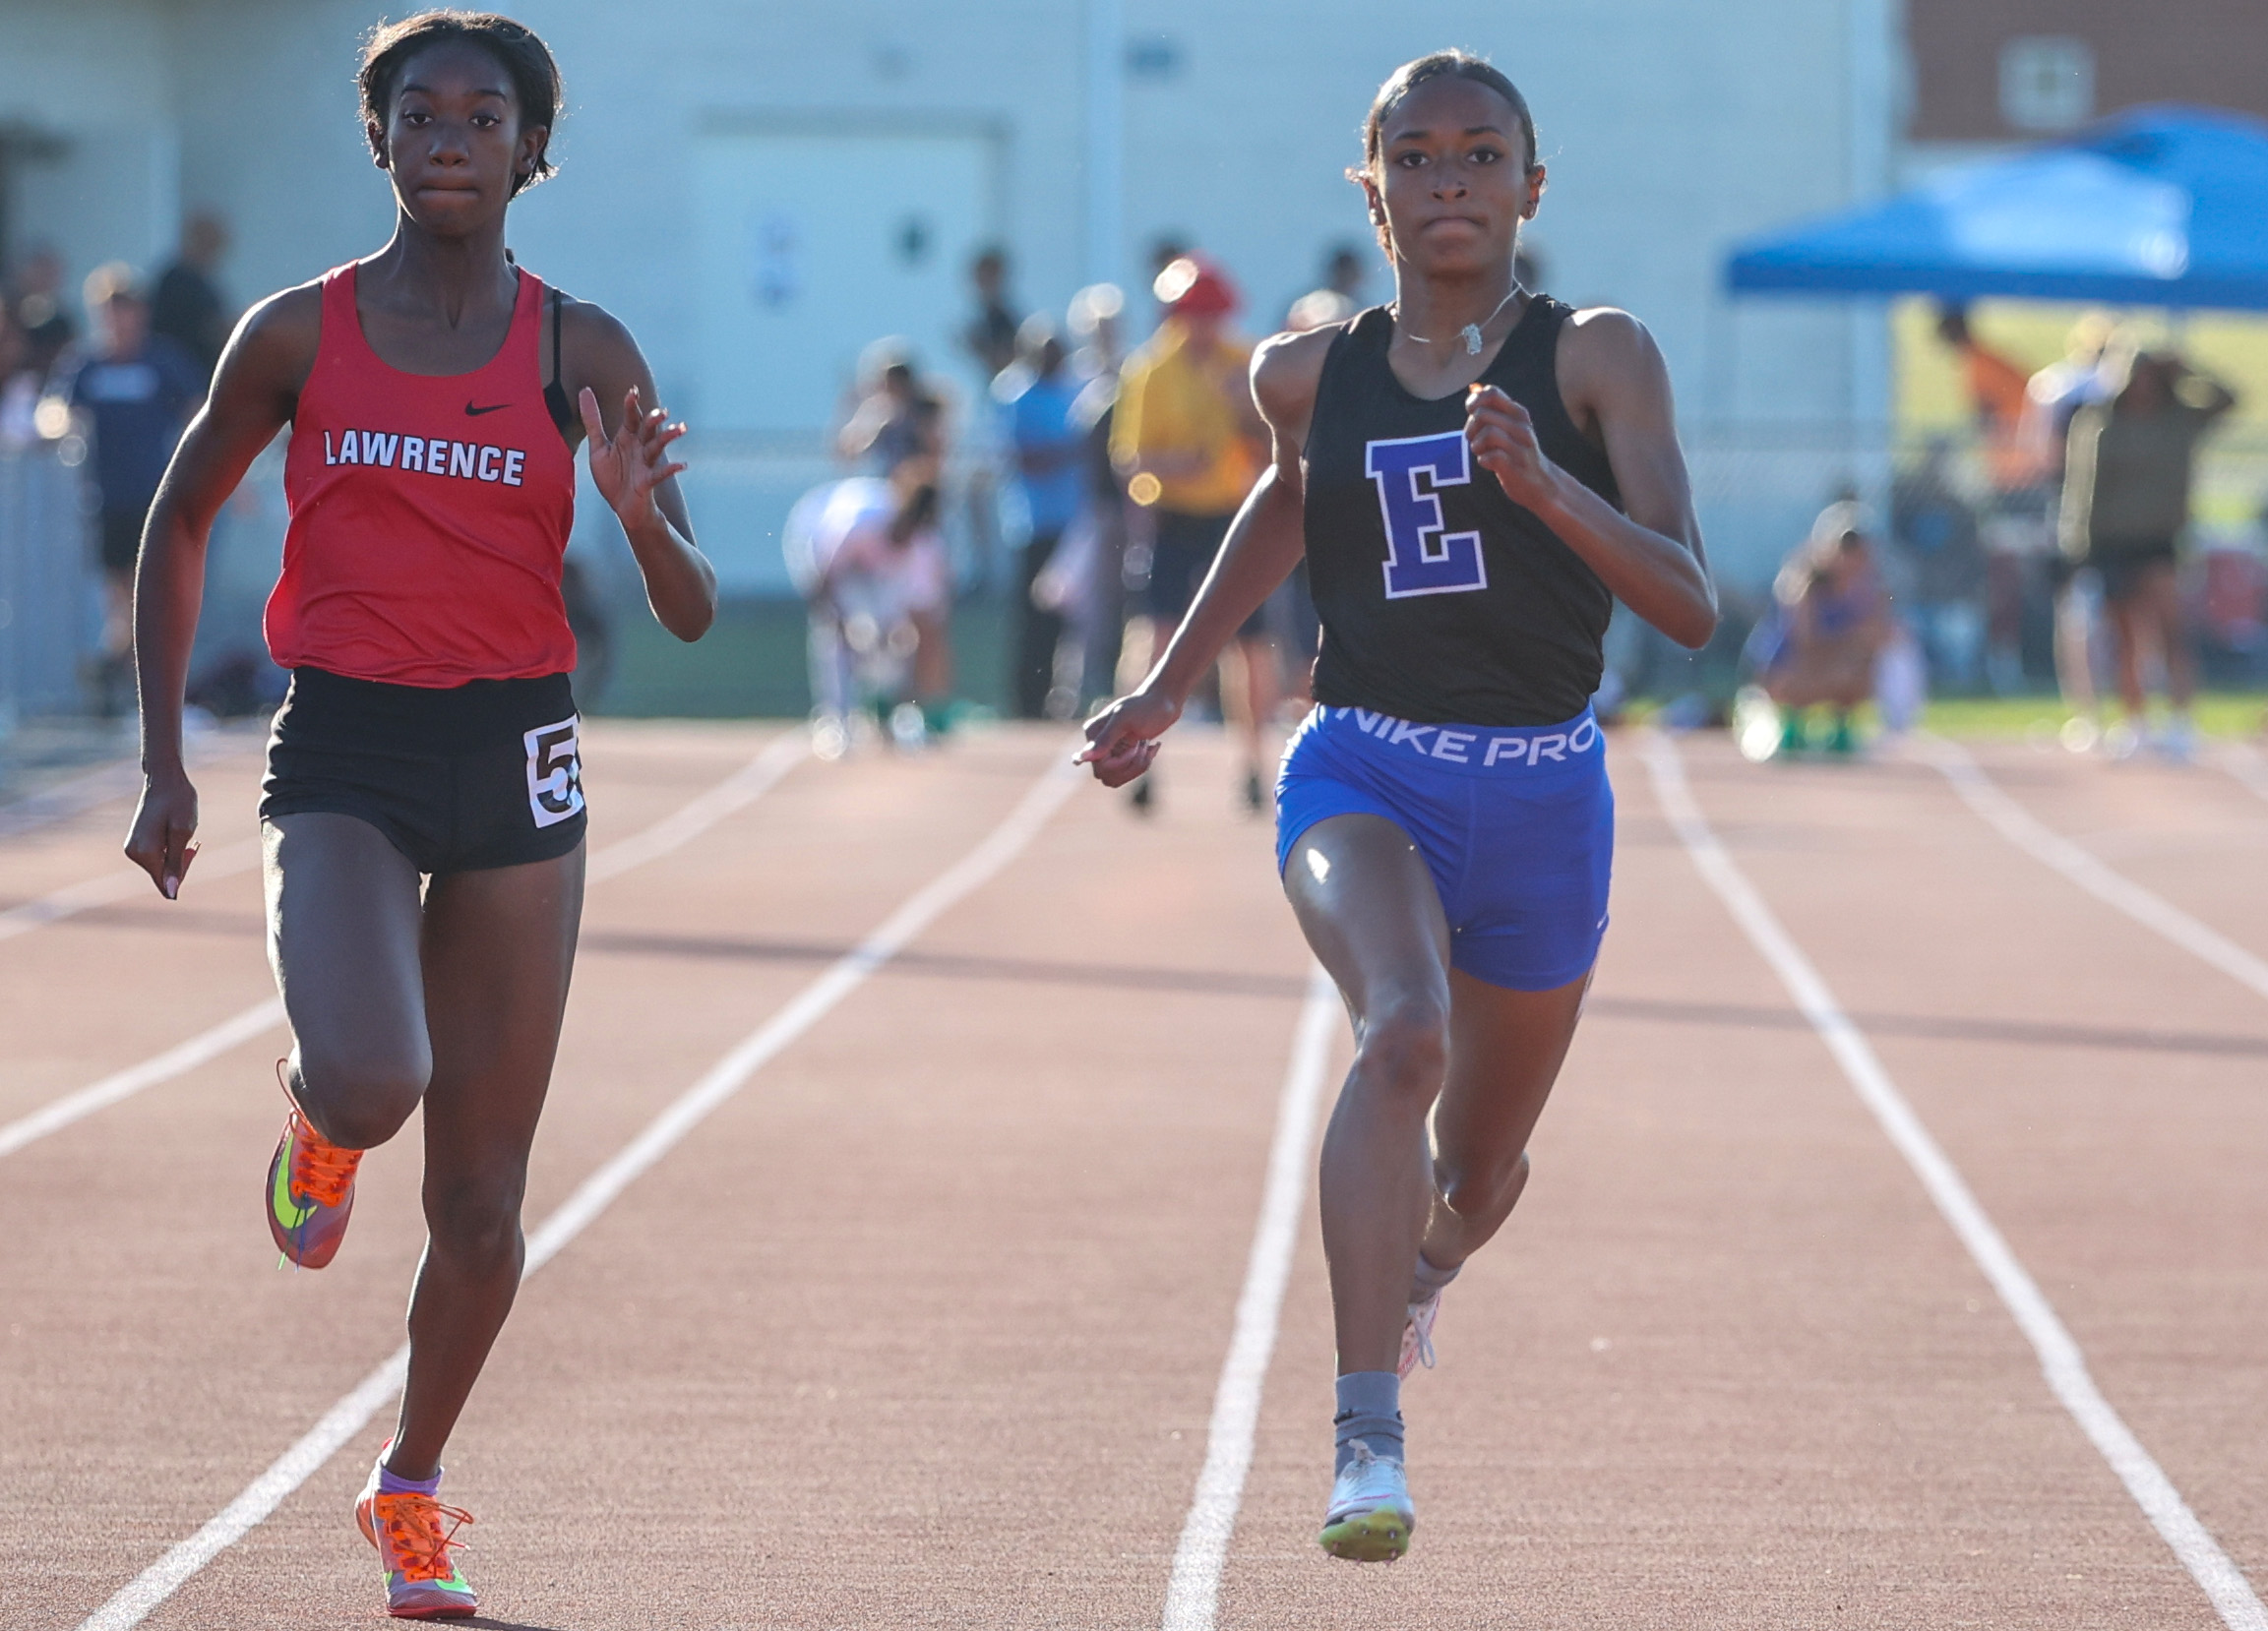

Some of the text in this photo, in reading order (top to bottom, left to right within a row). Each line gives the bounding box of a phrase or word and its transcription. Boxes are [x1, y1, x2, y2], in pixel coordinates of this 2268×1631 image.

[323, 428, 525, 486] LAWRENCE
[1366, 430, 1488, 599] E
[535, 723, 576, 814] 5
[1334, 705, 1596, 766] NIKE PRO
